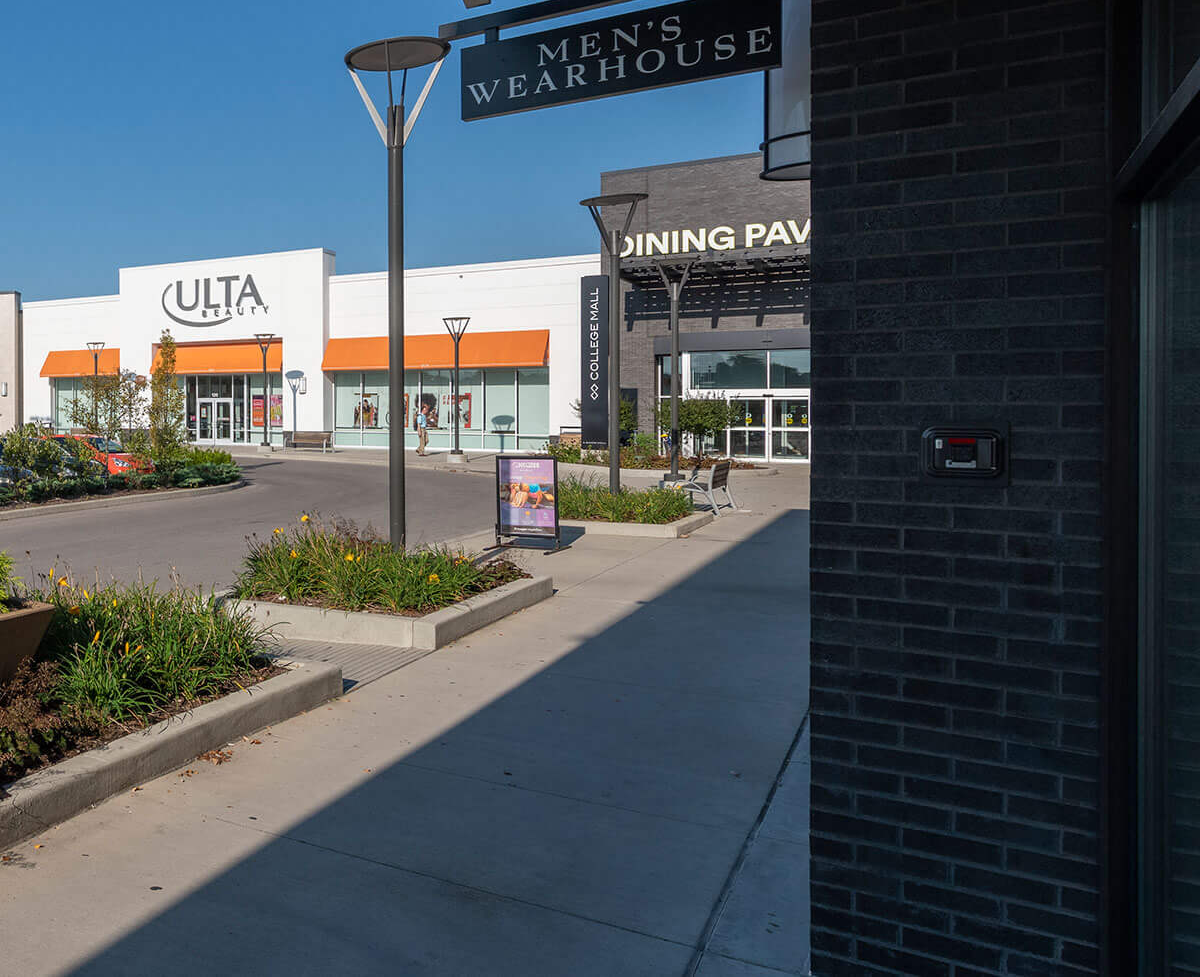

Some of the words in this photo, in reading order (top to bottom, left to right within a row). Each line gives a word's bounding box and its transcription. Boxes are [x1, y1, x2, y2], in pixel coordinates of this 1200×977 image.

[537, 15, 682, 67] MEN'S
[466, 25, 773, 106] WEARHOUSE
[176, 274, 264, 312] ULTA
[202, 305, 269, 318] BEAUTY
[590, 287, 600, 321] MALL
[590, 322, 599, 381] COLLEGE
